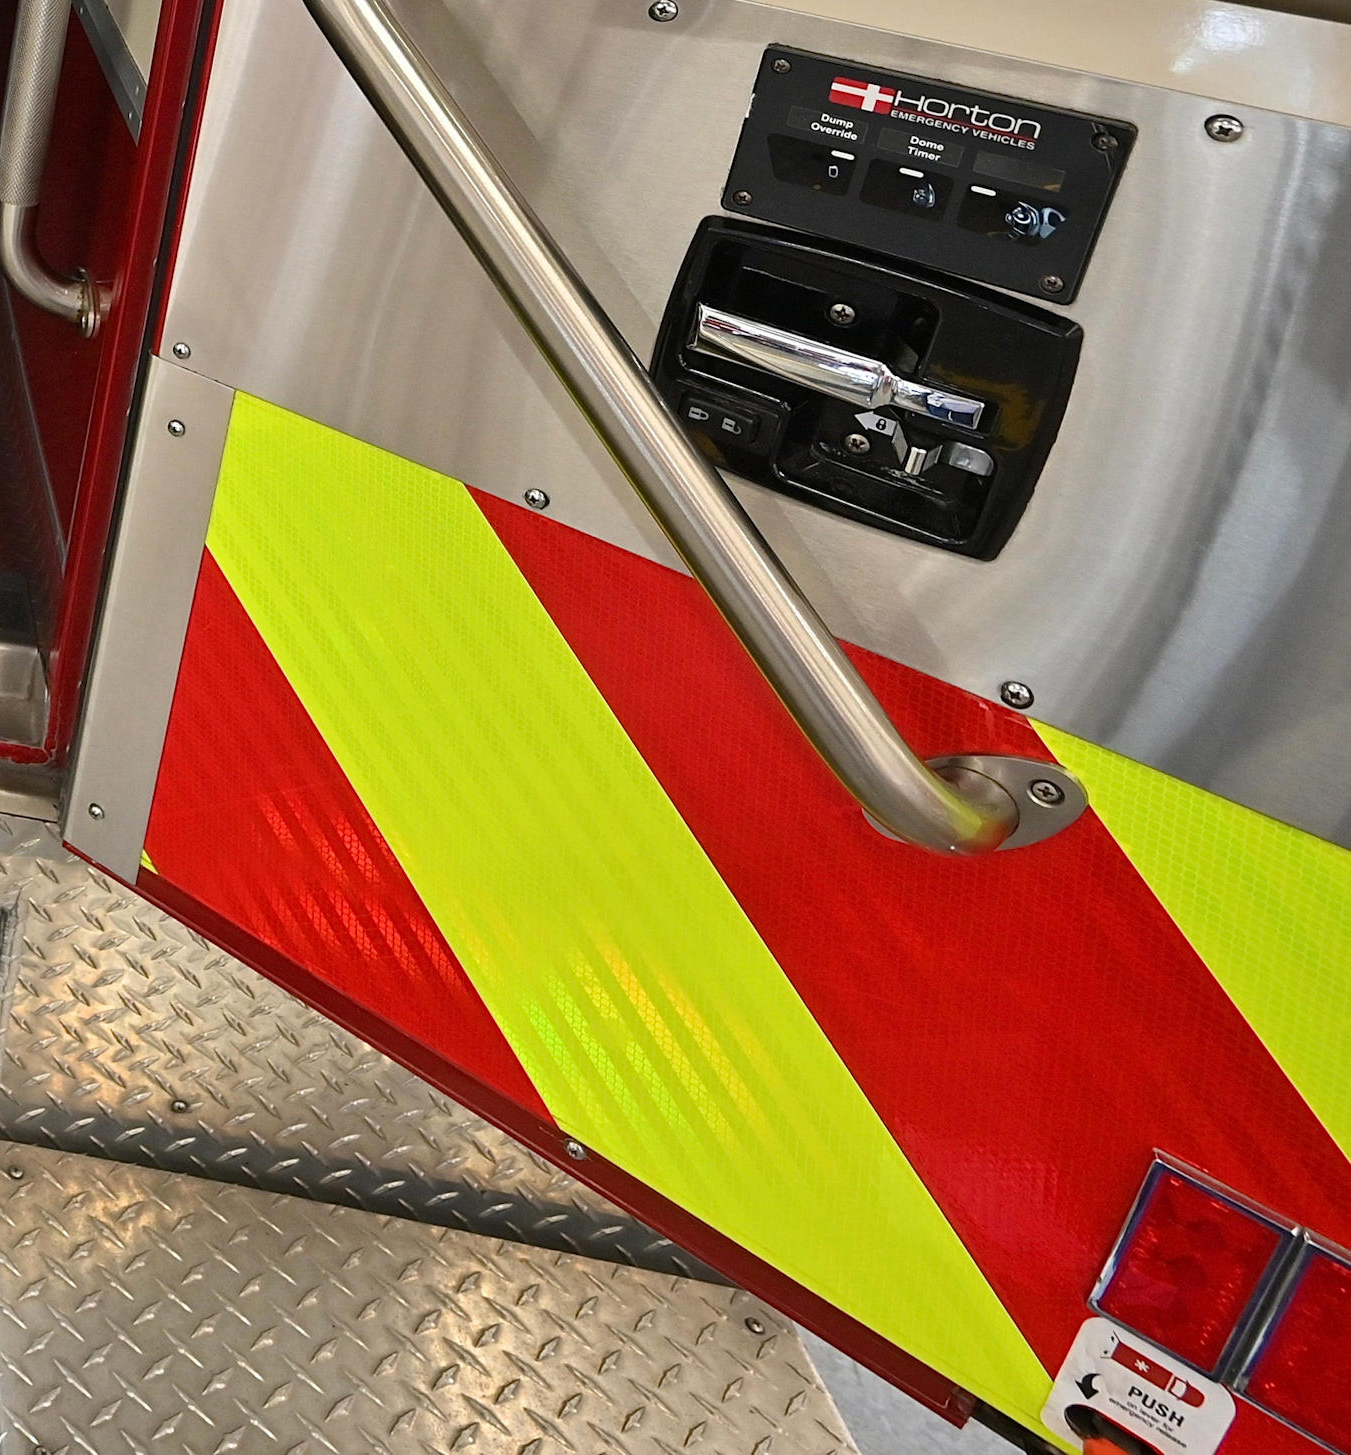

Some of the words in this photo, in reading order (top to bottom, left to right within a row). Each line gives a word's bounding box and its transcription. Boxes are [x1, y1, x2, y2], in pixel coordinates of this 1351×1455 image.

[821, 113, 854, 130] Dump
[894, 90, 1041, 140] Horton
[810, 122, 858, 141] Override
[890, 110, 969, 135] EMERGENCY
[972, 129, 1036, 151] VEHICLES
[907, 146, 941, 162] Timer
[910, 135, 945, 152] Dome
[1109, 1397, 1154, 1429] emergency
[1128, 1386, 1185, 1428] PUSH
